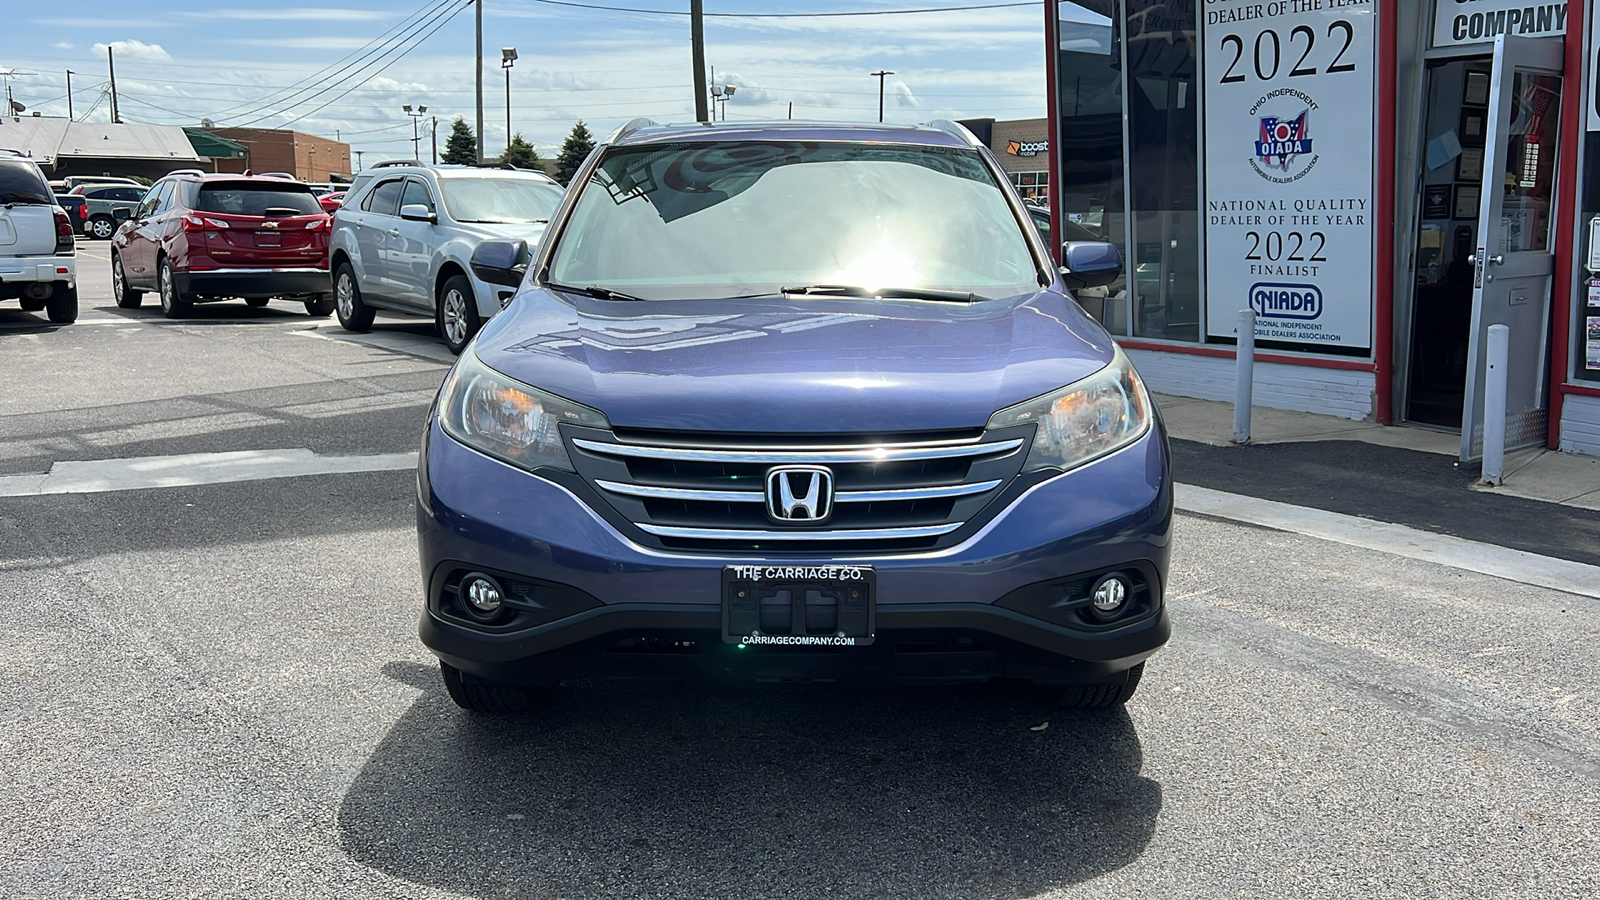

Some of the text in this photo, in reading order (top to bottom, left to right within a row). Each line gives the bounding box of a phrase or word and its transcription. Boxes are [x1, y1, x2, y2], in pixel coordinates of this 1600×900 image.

[1208, 4, 1264, 25] DEALER
[1267, 2, 1287, 17] OF
[1292, 0, 1323, 14] THE
[1452, 3, 1568, 41] COMPANY
[1220, 20, 1356, 84] 2022
[1249, 88, 1319, 116] OHIO INDEPENDENT
[1021, 140, 1048, 151] boost
[1261, 140, 1303, 155] OIADA
[1248, 157, 1272, 182] AUTOMOBILE
[1293, 154, 1320, 181] ASSOCIATION
[1209, 198, 1367, 213] NATIONAL QUALITY
[1211, 215, 1365, 226] DEALER OF THE YEAR
[1244, 231, 1327, 262] 2022
[1250, 264, 1319, 277] FINALIST
[1254, 290, 1315, 312] NIADA
[1254, 320, 1322, 331] ATIONAL INDEPENDENT
[1271, 330, 1297, 338] DEALERS
[1298, 332, 1341, 341] ASSOCIATION
[735, 567, 864, 580] THE CARRIAGE CO.
[742, 636, 855, 646] CARRIAGECOMPANY.COM
